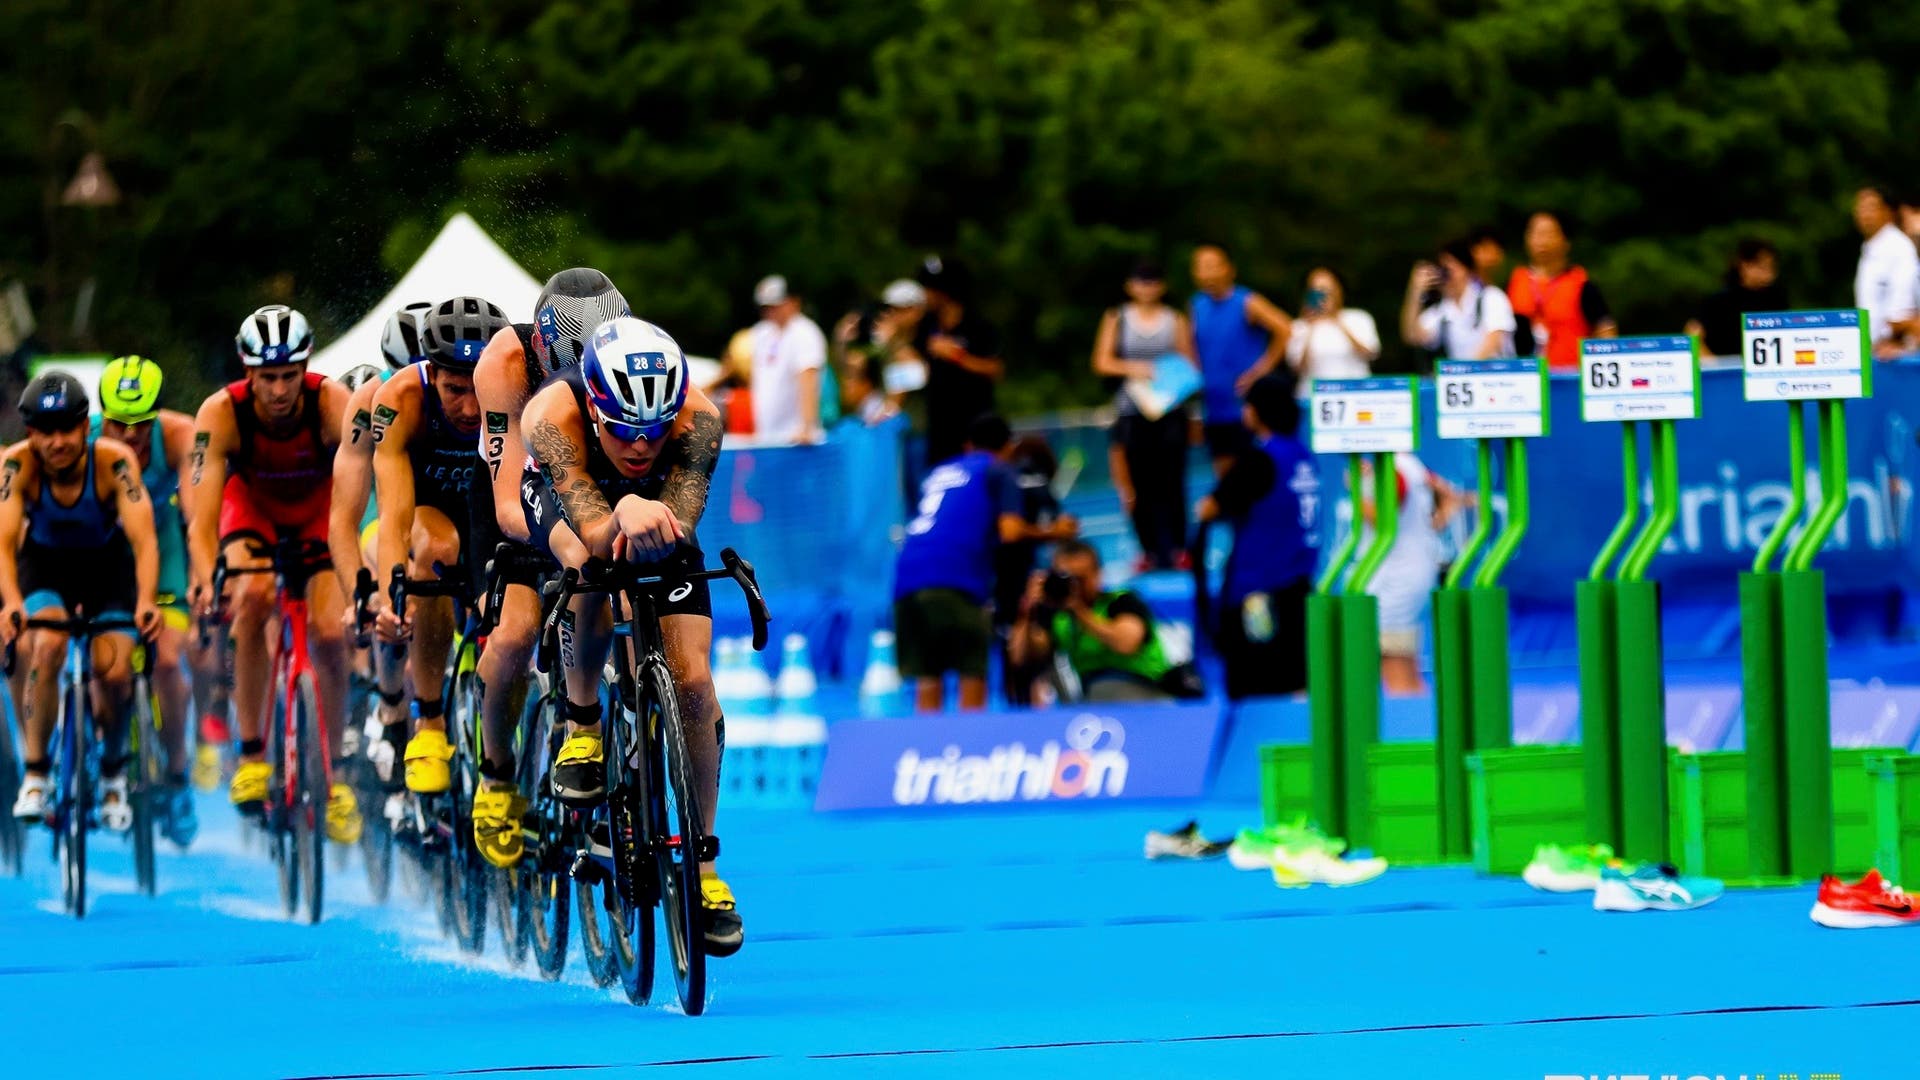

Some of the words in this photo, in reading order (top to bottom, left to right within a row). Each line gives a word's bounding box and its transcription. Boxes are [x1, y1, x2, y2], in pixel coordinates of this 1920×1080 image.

[463, 344, 472, 356] 5
[1752, 337, 1782, 365] 61
[633, 357, 649, 371] 28
[1591, 362, 1620, 388] 63
[1446, 382, 1473, 407] 65
[1321, 400, 1346, 424] 67
[372, 424, 384, 443] 5
[488, 436, 504, 482] 37
[893, 740, 1129, 804] triathlon
